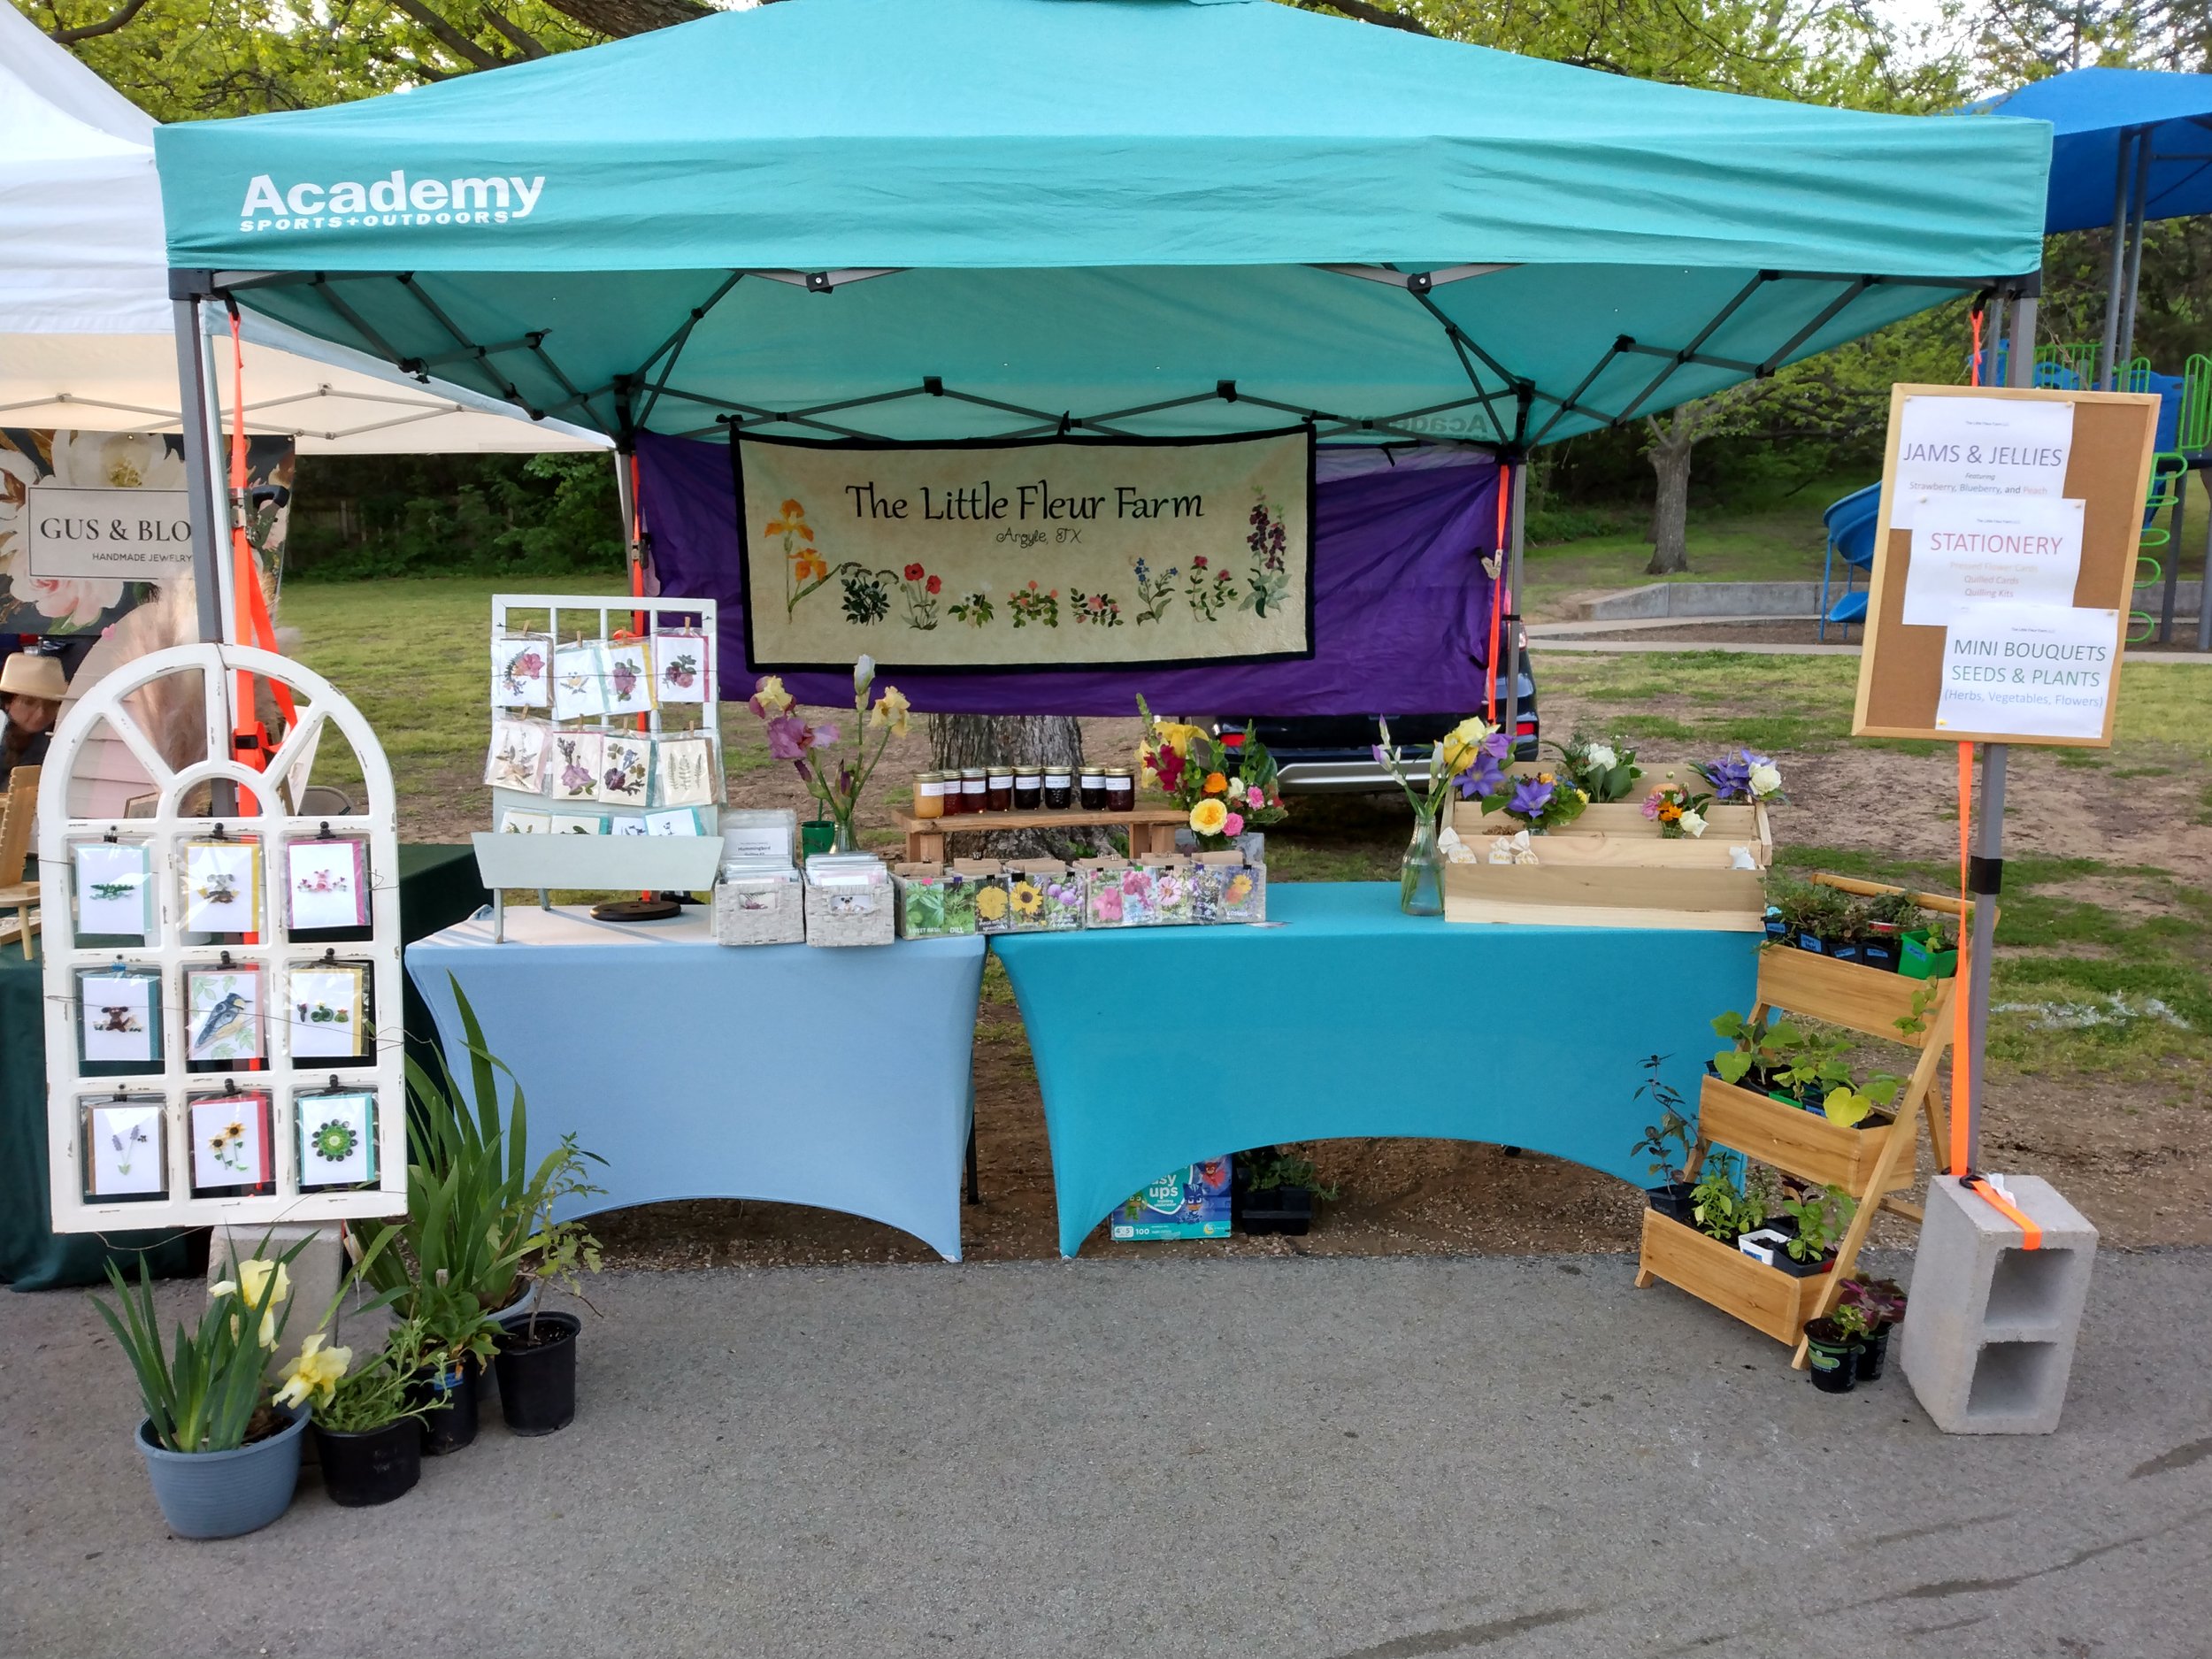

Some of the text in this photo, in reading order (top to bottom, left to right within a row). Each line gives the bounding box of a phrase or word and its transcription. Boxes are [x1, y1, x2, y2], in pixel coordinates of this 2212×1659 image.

[240, 169, 546, 219] Academy
[240, 211, 509, 232] SPORTS+OUTDOORS
[1903, 443, 2062, 467] JAMS & JELLIES
[1965, 472, 1996, 480] Featuring
[1909, 480, 2047, 495] Strawberry, Blueberry, and Peach
[845, 480, 1204, 520] The Little Fleur Farm
[40, 518, 192, 541] GUS & BLO
[995, 526, 1082, 549] Argyle, TX
[1931, 532, 2063, 555] STATIONERY
[92, 553, 192, 563] HANDMADE JEWELRY
[1949, 561, 2039, 573] Pressed Flower Cards
[1963, 575, 2019, 585] Quilled Cards
[1964, 588, 2014, 598] Quilling Kits
[1954, 639, 2107, 662] MINI BOUQUETS
[1952, 665, 2101, 687] SEEDS & PLANTS
[1945, 689, 2103, 708] (Herbs, Vegetables, Flowers)
[1152, 1174, 1177, 1187] sy
[1149, 1187, 1179, 1199] ups
